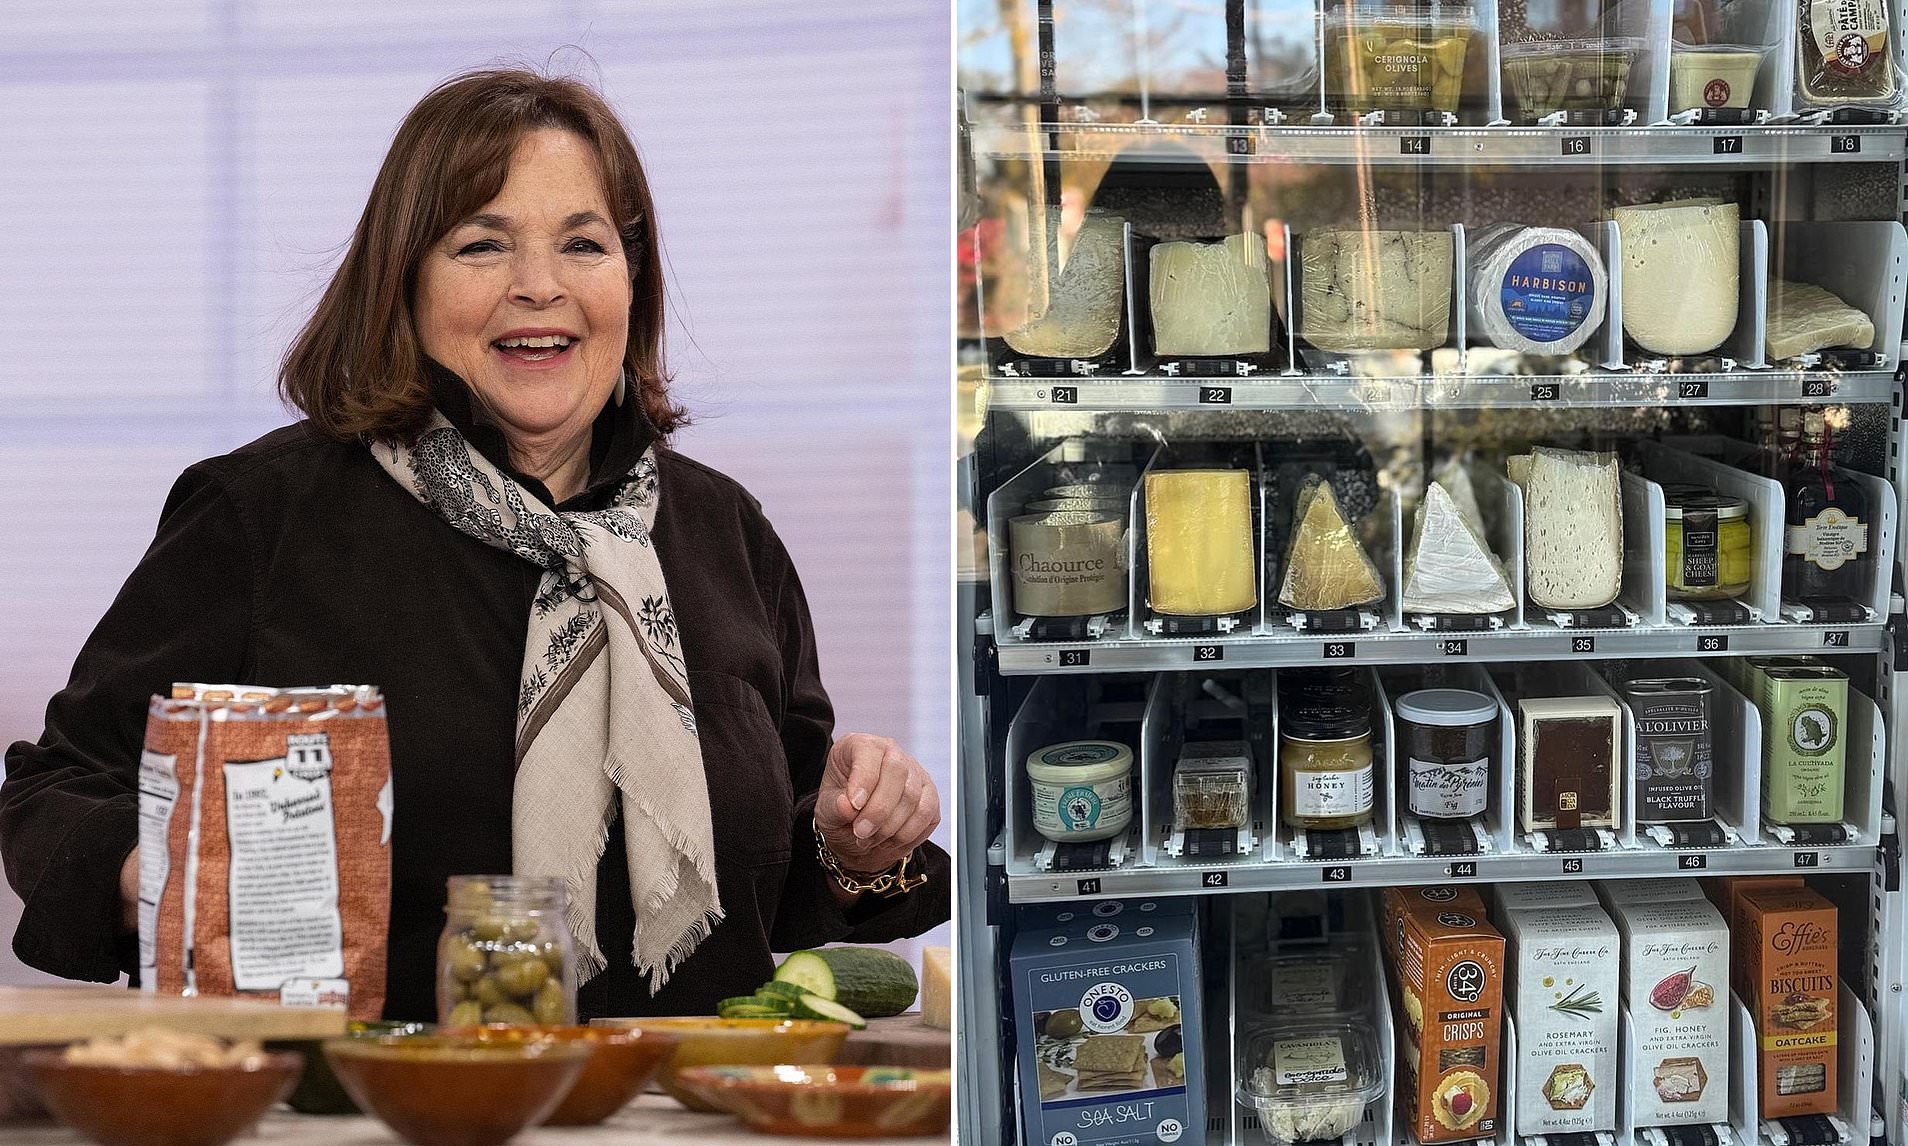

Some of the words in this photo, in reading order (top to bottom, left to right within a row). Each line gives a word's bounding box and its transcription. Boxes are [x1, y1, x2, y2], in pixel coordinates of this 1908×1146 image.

[1374, 55, 1429, 64] CERIGNOLA
[1385, 64, 1418, 72] OLIVES
[1232, 139, 1247, 152] 13
[1406, 139, 1423, 152] 14
[1559, 139, 1575, 152] 16
[1719, 138, 1736, 151] 17
[1838, 138, 1854, 151] 18
[1511, 275, 1586, 293] HARBISON
[1056, 389, 1071, 402] 21
[1208, 389, 1225, 402] 22
[1537, 386, 1553, 399] 25
[1686, 384, 1701, 396] 27
[1808, 383, 1824, 395] 28
[1019, 553, 1105, 573] Chaource
[1687, 557, 1714, 565] SHEEP
[1693, 563, 1717, 571] GOAT
[1685, 570, 1716, 578] CHEESE
[1574, 637, 1590, 651] 35
[1702, 636, 1718, 650] 36
[1827, 631, 1843, 645] 37
[1199, 646, 1216, 659] 32
[1328, 643, 1345, 657] 33
[1446, 639, 1461, 653] 34
[1065, 651, 1080, 665] 31
[1645, 719, 1710, 733] L'OLIVIER
[295, 749, 322, 763] 11
[1307, 782, 1345, 790] HONEY
[1445, 800, 1458, 811] Fig
[1658, 801, 1696, 809] FLAVOUR
[1562, 858, 1578, 871] 45
[1683, 856, 1700, 869] 46
[1796, 852, 1812, 865] 47
[1328, 867, 1345, 880] 43
[1454, 863, 1471, 876] 44
[1080, 879, 1096, 892] 41
[1205, 873, 1221, 886] 42
[1771, 922, 1831, 956] Effie's
[1447, 949, 1468, 963] LIGHT
[1476, 951, 1497, 979] CRUNCHY
[1040, 967, 1111, 983] GLUTEN-FREE
[1112, 960, 1167, 976] CRACKERS
[1770, 975, 1834, 995] BISCUITS
[1083, 984, 1130, 1008] ONESTO
[1447, 1012, 1483, 1020] ORIGINAL
[1443, 1021, 1485, 1042] CRISPS
[1546, 1030, 1594, 1040] ROSEMARY
[1654, 1026, 1672, 1035] FIG,
[1675, 1024, 1707, 1034] HONEY
[1578, 1039, 1601, 1047] VIRGIN
[1665, 1034, 1688, 1042] EXTRA
[1689, 1033, 1713, 1041] VIRGIN
[1775, 1036, 1827, 1048] OATCAKE
[1530, 1049, 1553, 1057] OLIVE
[1555, 1048, 1568, 1056] OIL
[1570, 1046, 1608, 1055] CRACKERS
[1641, 1043, 1664, 1051] OLIVE
[1666, 1042, 1679, 1050] OIL
[1681, 1040, 1720, 1050] CRACKERS
[1076, 1108, 1114, 1129] SEA
[1115, 1102, 1155, 1123] SALT
[1161, 1122, 1178, 1133] NO
[1056, 1136, 1073, 1146] NO
